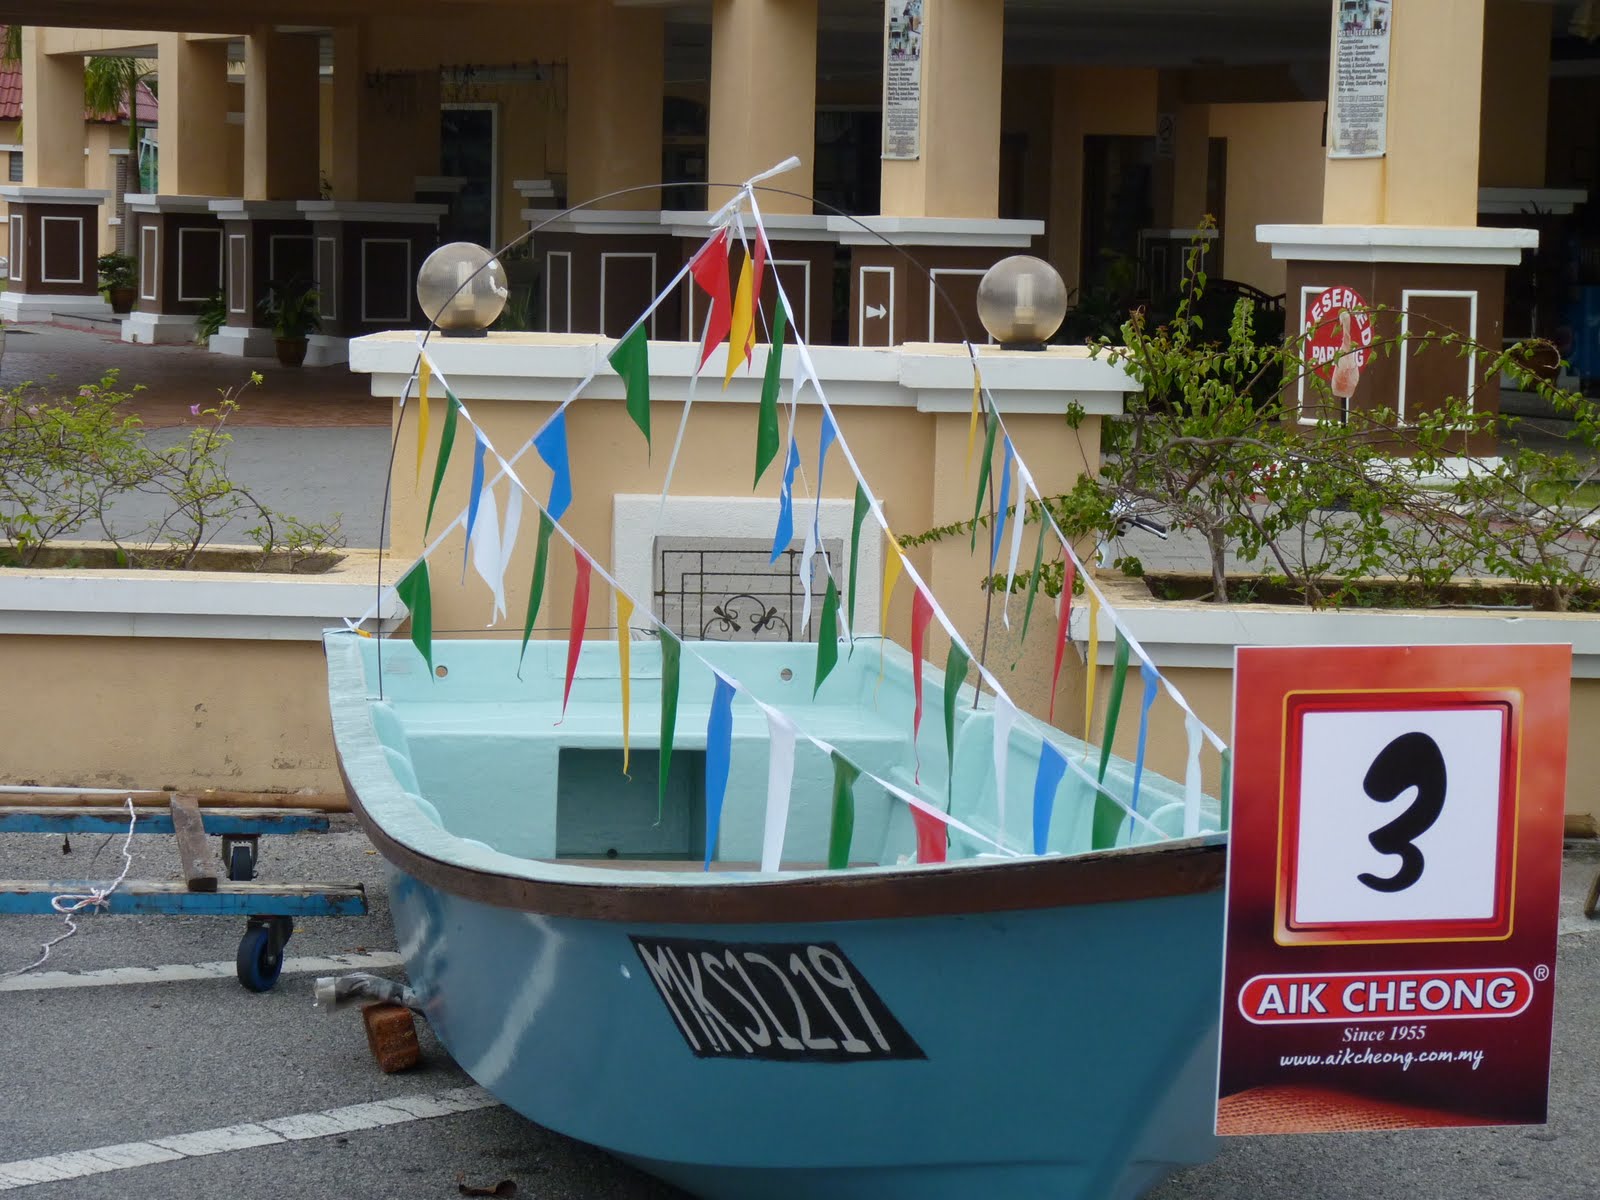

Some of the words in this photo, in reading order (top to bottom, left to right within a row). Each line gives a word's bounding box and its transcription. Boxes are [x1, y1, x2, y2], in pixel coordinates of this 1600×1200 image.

[1357, 731, 1447, 892] 3
[1255, 983, 1330, 1016] AIK
[1342, 976, 1517, 1014] CHEONG
[1342, 1027, 1386, 1043] Since
[1389, 1025, 1428, 1041] 1955
[1279, 1047, 1486, 1071] www.aikcheong.com.my
